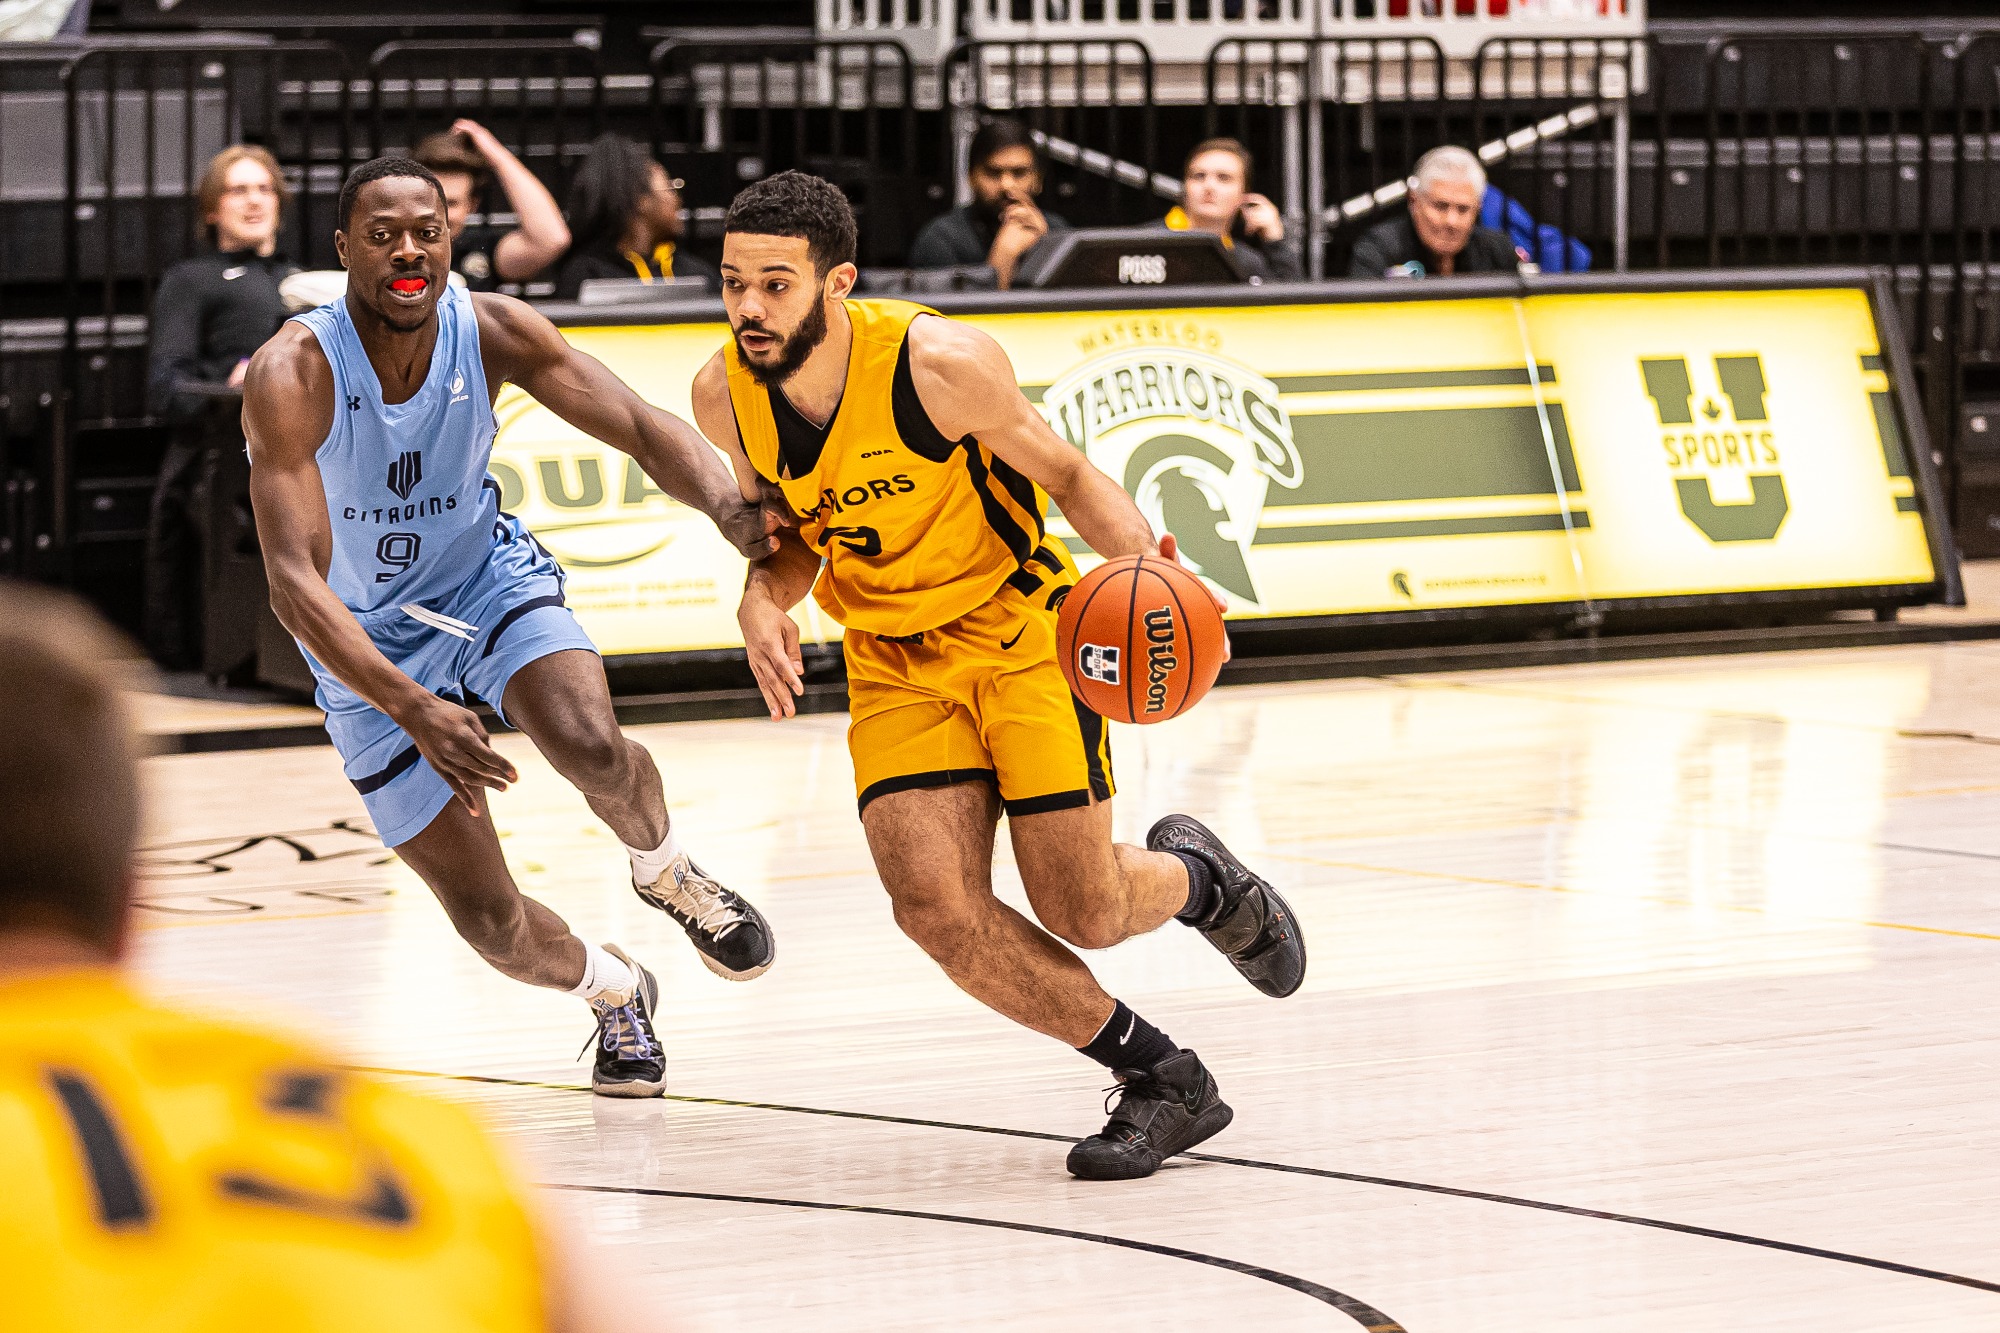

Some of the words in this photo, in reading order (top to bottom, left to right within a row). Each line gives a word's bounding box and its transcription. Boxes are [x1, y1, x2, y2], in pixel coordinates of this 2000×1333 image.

[1118, 255, 1167, 284] POSS
[1079, 320, 1222, 352] WATERLOO
[1048, 363, 1297, 480] WARRIORS
[860, 449, 894, 459] OUA
[1663, 432, 1778, 467] SPORTS
[343, 494, 457, 524] CITADINS
[375, 532, 422, 583] 9
[1094, 647, 1102, 680] SPORTS
[1143, 605, 1178, 714] Wilson
